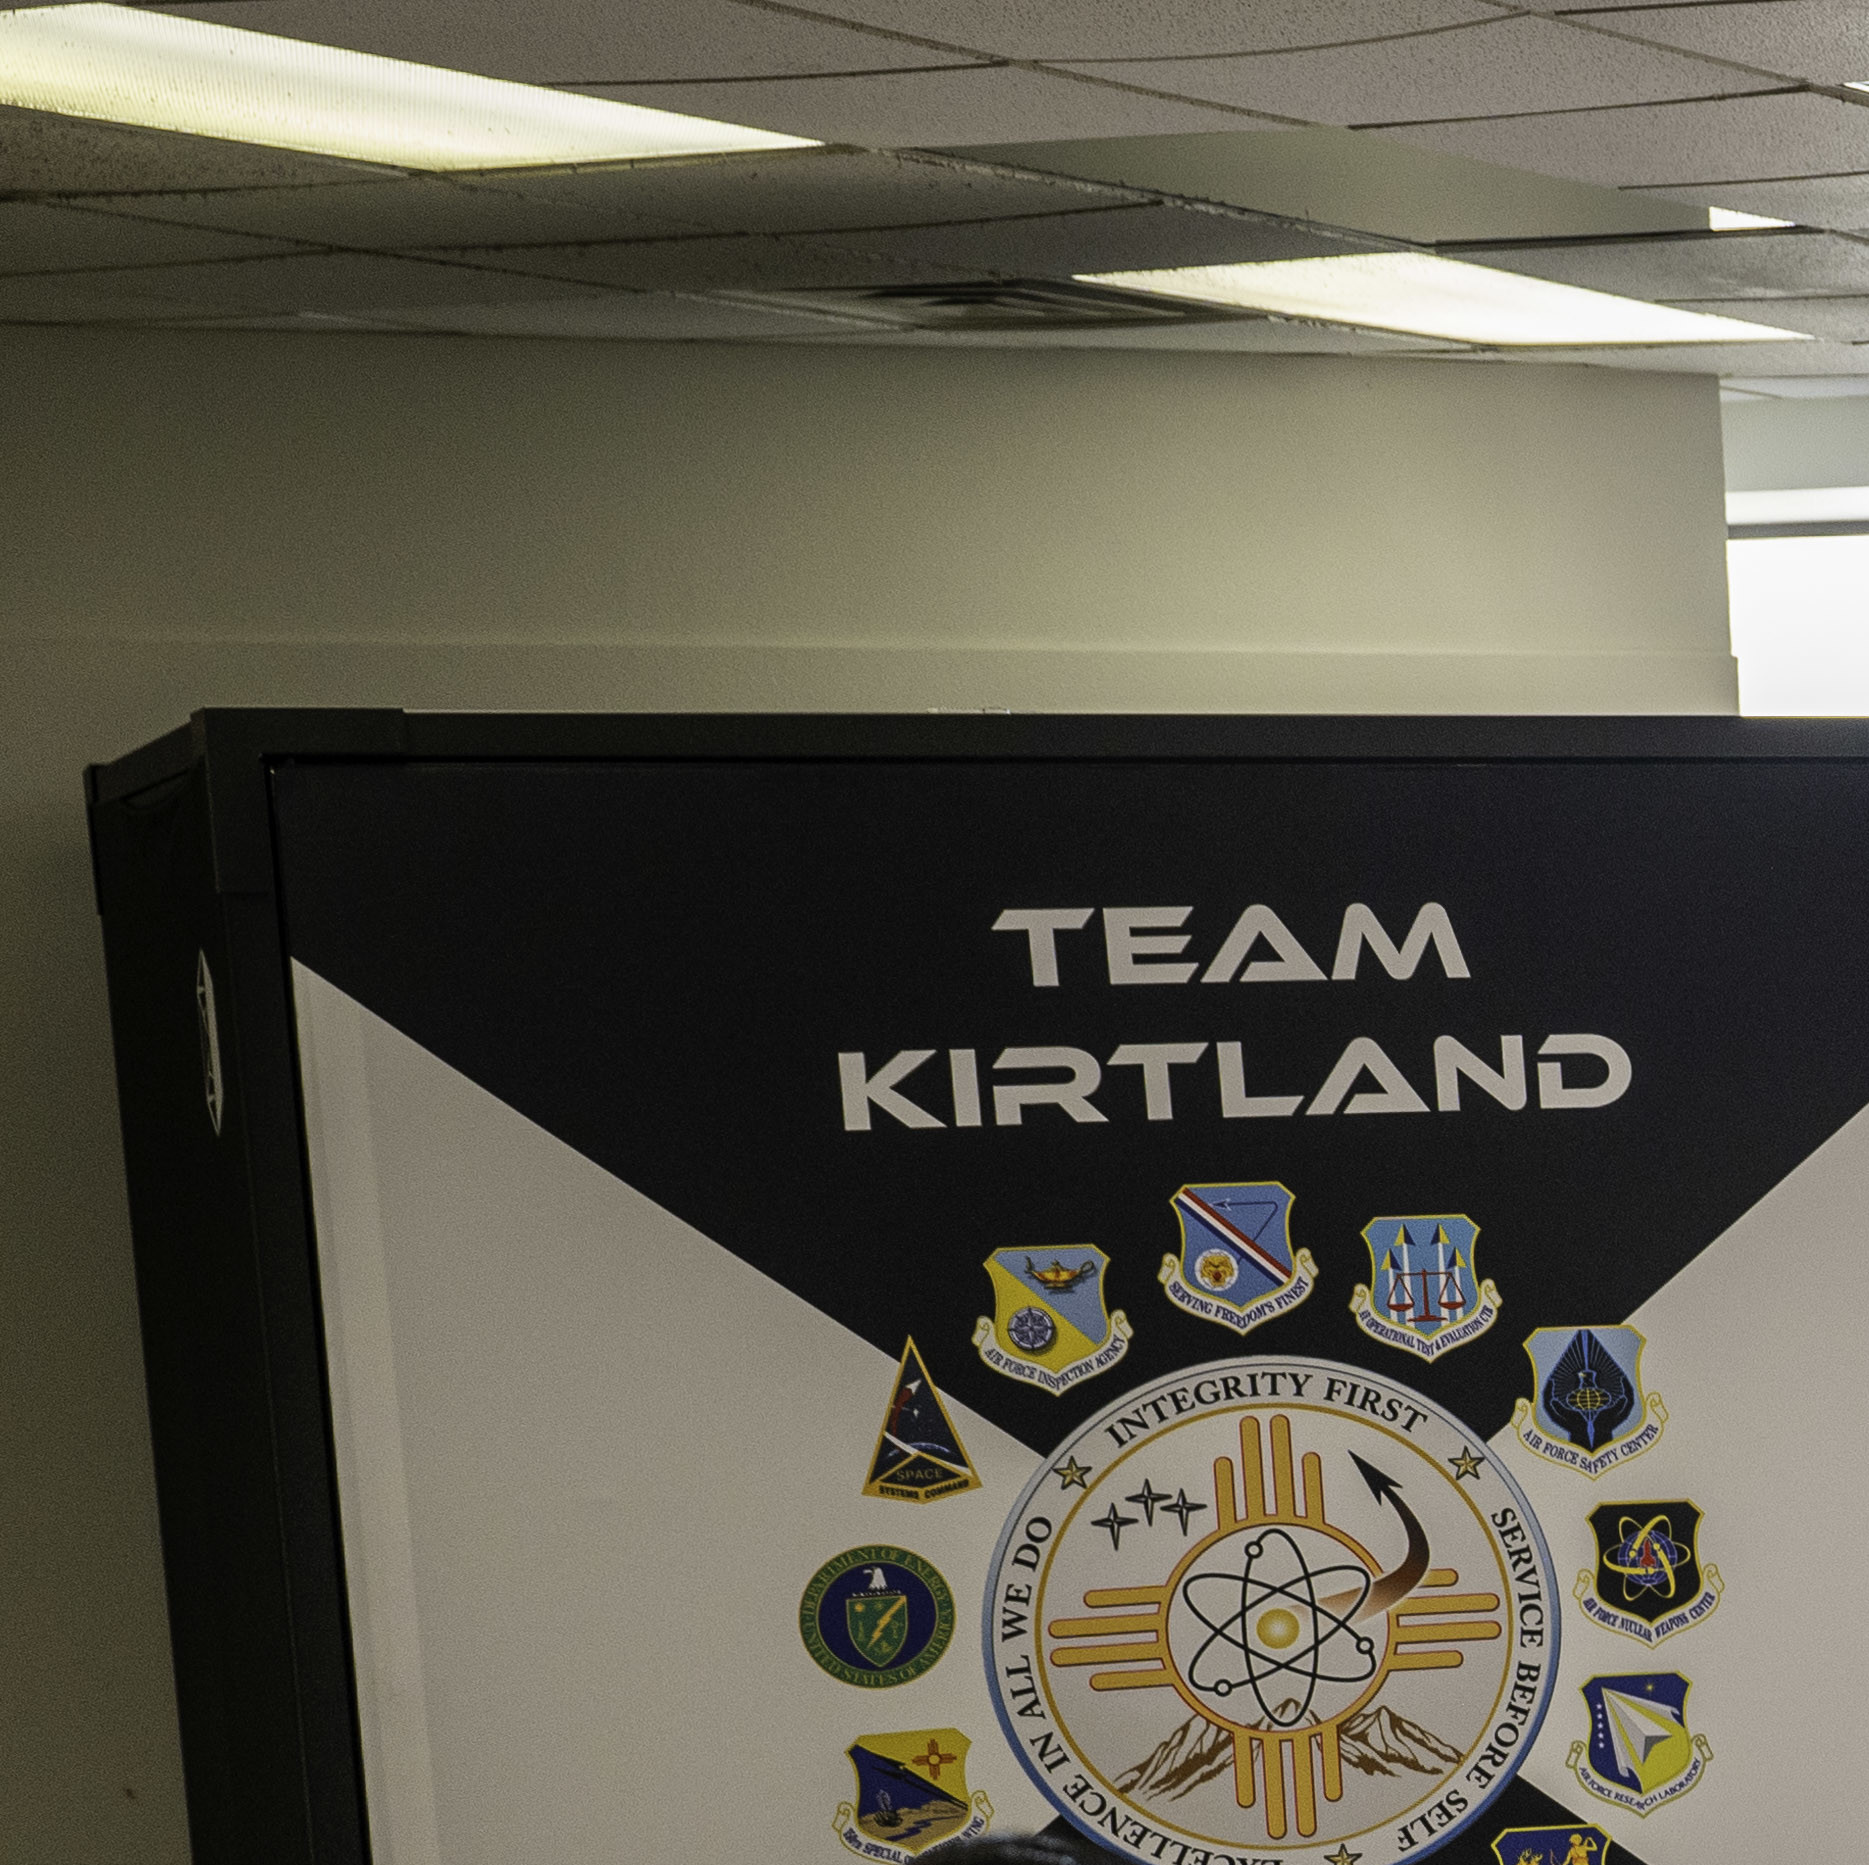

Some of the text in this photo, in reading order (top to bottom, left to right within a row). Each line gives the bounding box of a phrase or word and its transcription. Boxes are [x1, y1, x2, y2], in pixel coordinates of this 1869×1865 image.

[992, 902, 1470, 988] TEAM
[838, 1034, 1633, 1131] KIRTLAND
[1169, 1280, 1309, 1331] SERVING FREEDOM'S FINEST
[985, 1334, 1126, 1391] AIR FORCE INSPECTION AGENCY
[1366, 1319, 1416, 1349] OPERATIONAL
[1417, 1339, 1435, 1357] TEST
[1441, 1318, 1484, 1348] EVALUATION
[1104, 1371, 1428, 1449] INTEGRITY FIRST
[896, 1467, 943, 1481] SPACE
[1522, 1423, 1659, 1474] AIR FORCE SAFETY CENTER
[1013, 1515, 1053, 1571] DO
[1001, 1583, 1032, 1643] WE
[1582, 1591, 1716, 1644] AIR FORCE NUCLEAR WEAPONS CENTER
[1005, 1654, 1046, 1723] ALL
[1397, 1507, 1545, 1852] SERVICE BEFORE SELF
[1029, 1730, 1071, 1775] IN
[1579, 1757, 1701, 1811] AIR FORCE RESEARCH LABORATORY
[862, 1842, 902, 1865] SPECIAL
